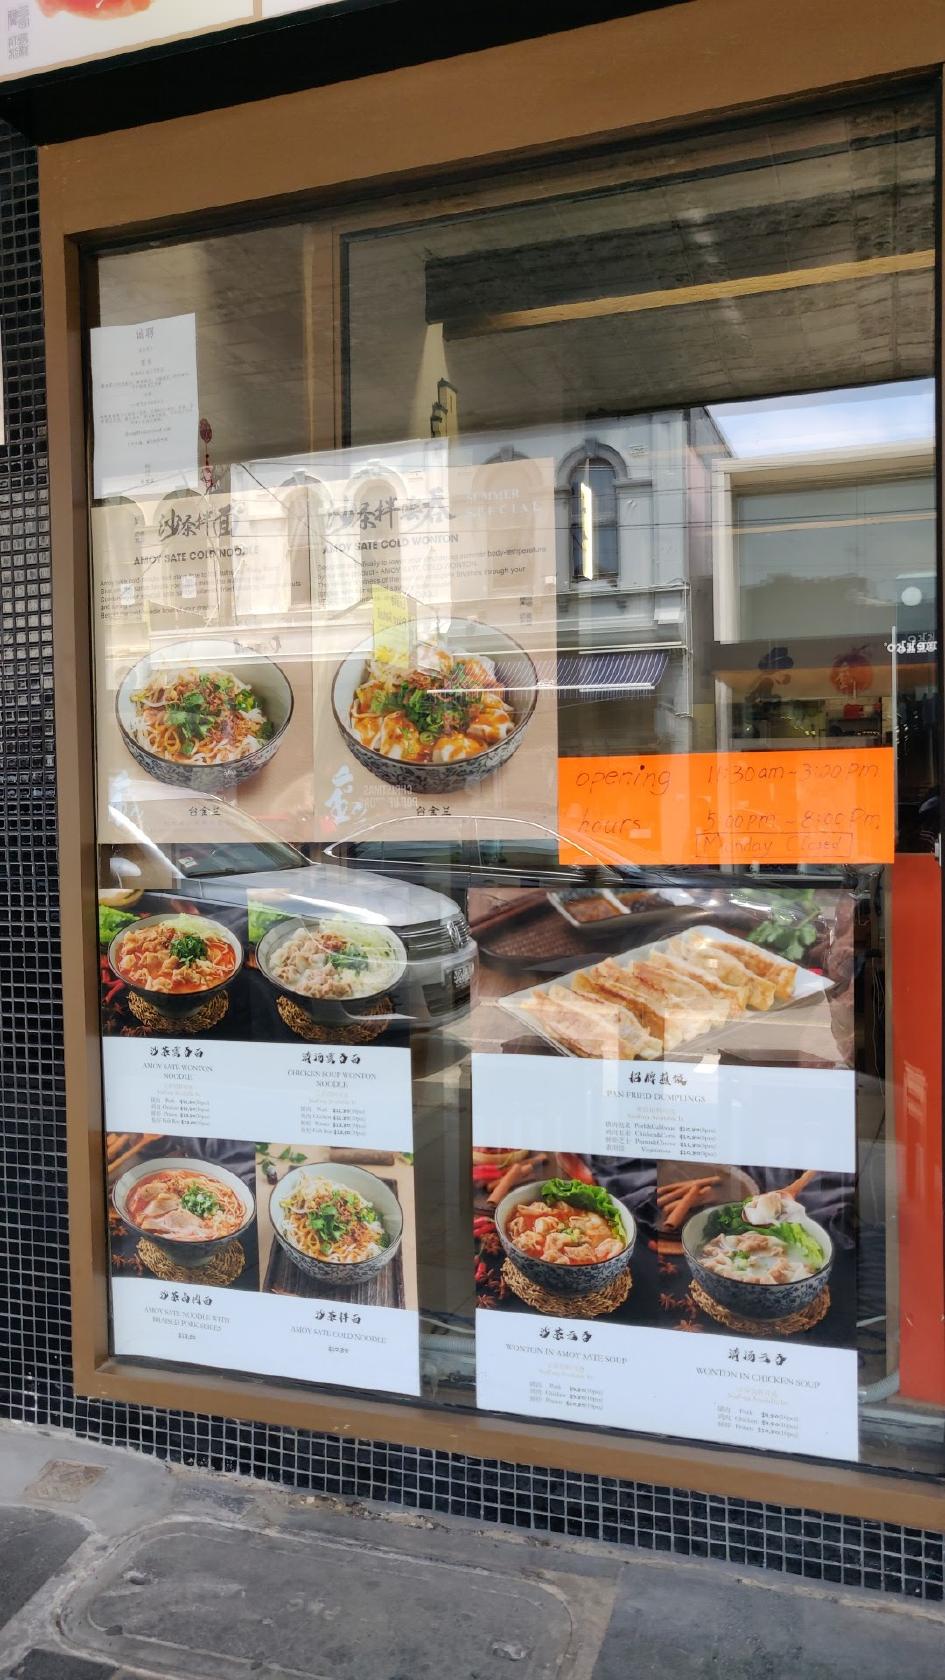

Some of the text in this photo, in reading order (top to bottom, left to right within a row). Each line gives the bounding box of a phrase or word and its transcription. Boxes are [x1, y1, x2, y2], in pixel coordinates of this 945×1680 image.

[356, 541, 378, 551] SATE
[380, 538, 409, 550] COLD
[412, 533, 459, 546] WONTON
[164, 552, 187, 562] SATE
[190, 549, 215, 561] COLD
[576, 763, 671, 796] opening
[578, 807, 641, 834] hours
[143, 1062, 161, 1070] AMOY
[181, 1064, 213, 1072] WONTON
[287, 1069, 377, 1080] CHICKEN SOUP WONTON
[163, 1073, 193, 1081] NOODLE
[315, 1081, 348, 1089] NOODLE
[607, 1090, 706, 1103] PAN FRIED DUMPLINGS
[144, 1305, 163, 1315] AMOY
[164, 1309, 181, 1318] SATE
[181, 1311, 211, 1322] NOODLE
[181, 1319, 199, 1329] PORK
[290, 1326, 388, 1344] AMOY SATE COLD NOODLE
[505, 1342, 628, 1366] WONTON IN AMOY SATE SOUP
[696, 1366, 822, 1390] WONTON IN CHICKEN SOUP
